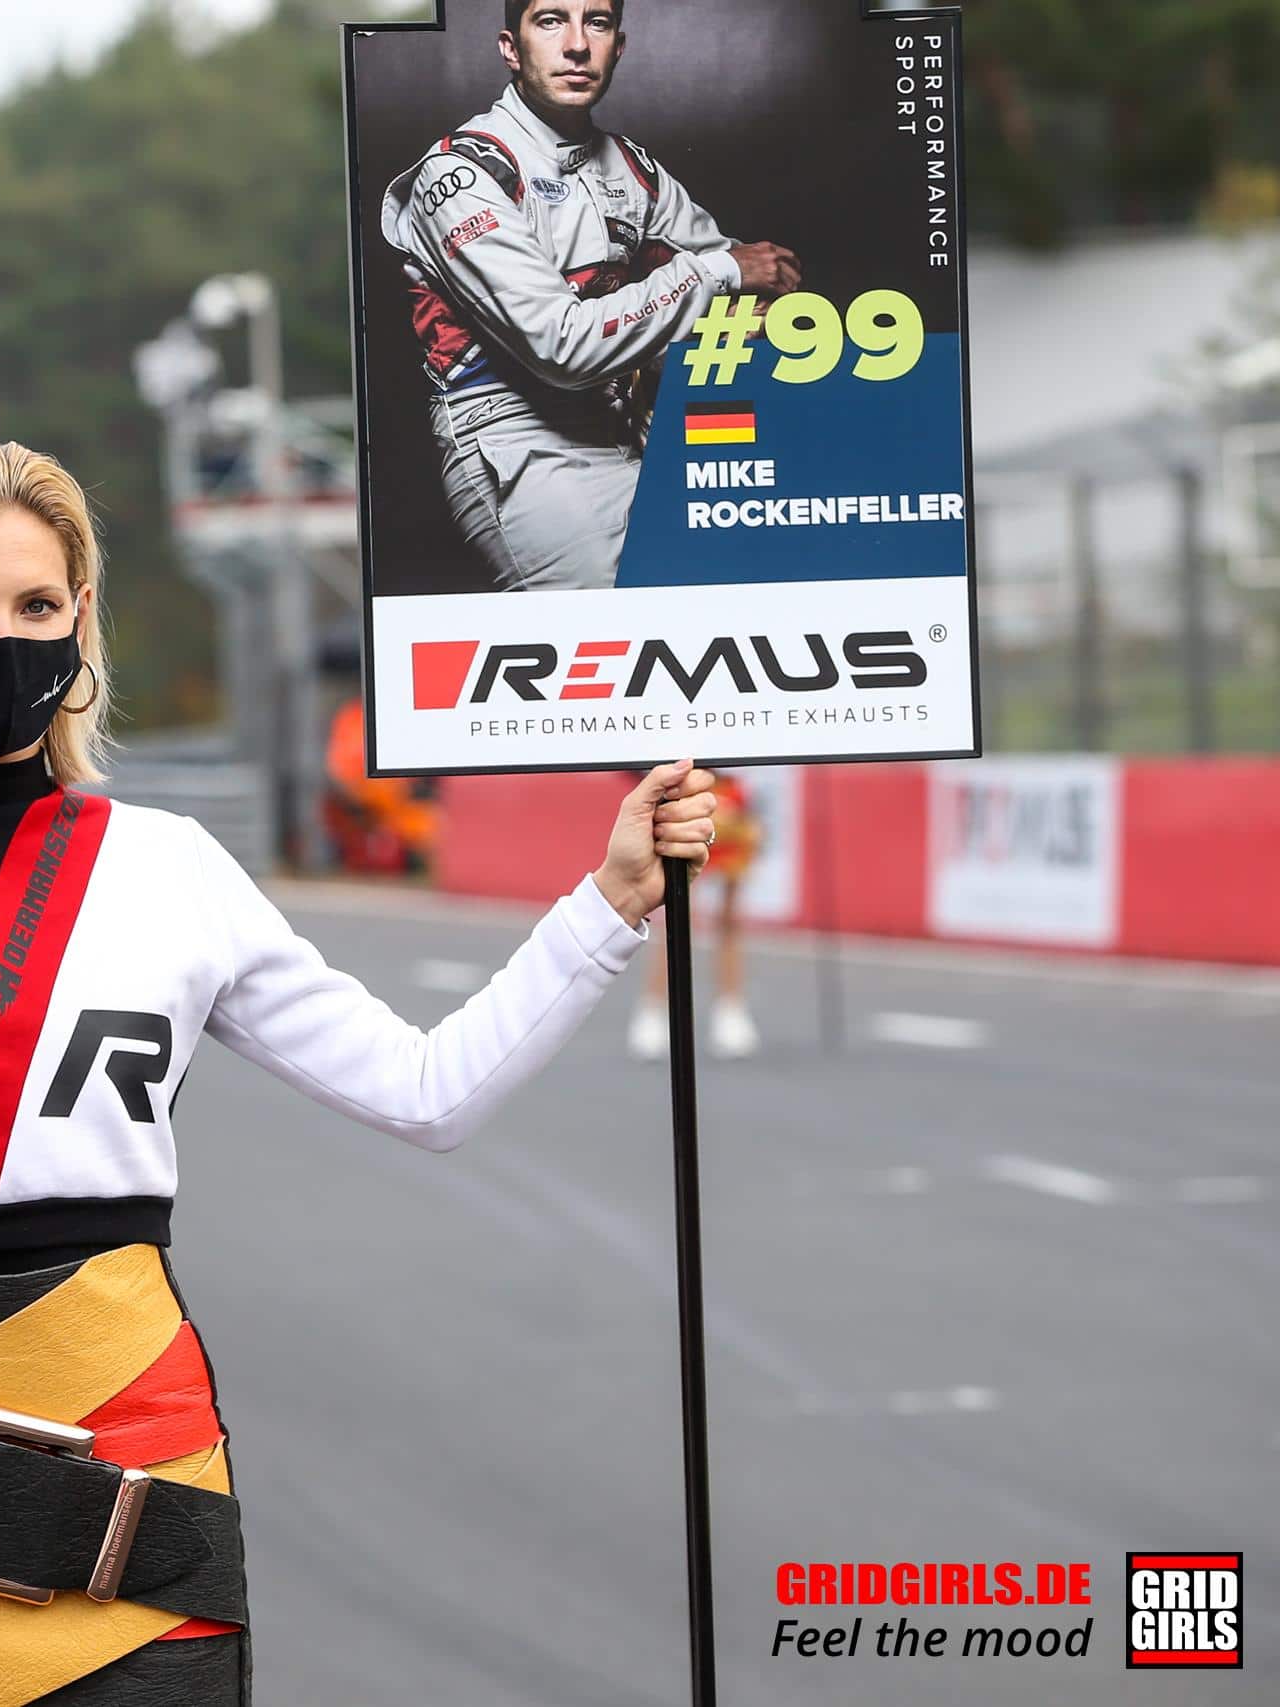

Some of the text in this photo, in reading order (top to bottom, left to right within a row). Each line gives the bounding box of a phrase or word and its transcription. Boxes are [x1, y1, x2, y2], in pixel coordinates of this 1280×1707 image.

[895, 35, 917, 135] SPORT
[924, 34, 950, 268] PERFORMANCE
[623, 273, 701, 326] Audi Sport
[682, 288, 925, 387] #99
[685, 458, 776, 489] MIKE
[687, 493, 964, 529] ROCKENFELLER
[469, 630, 928, 704] REMUS
[470, 704, 929, 737] PERFORMANCE SPORT EXHAUSTS
[38, 1009, 173, 1124] R
